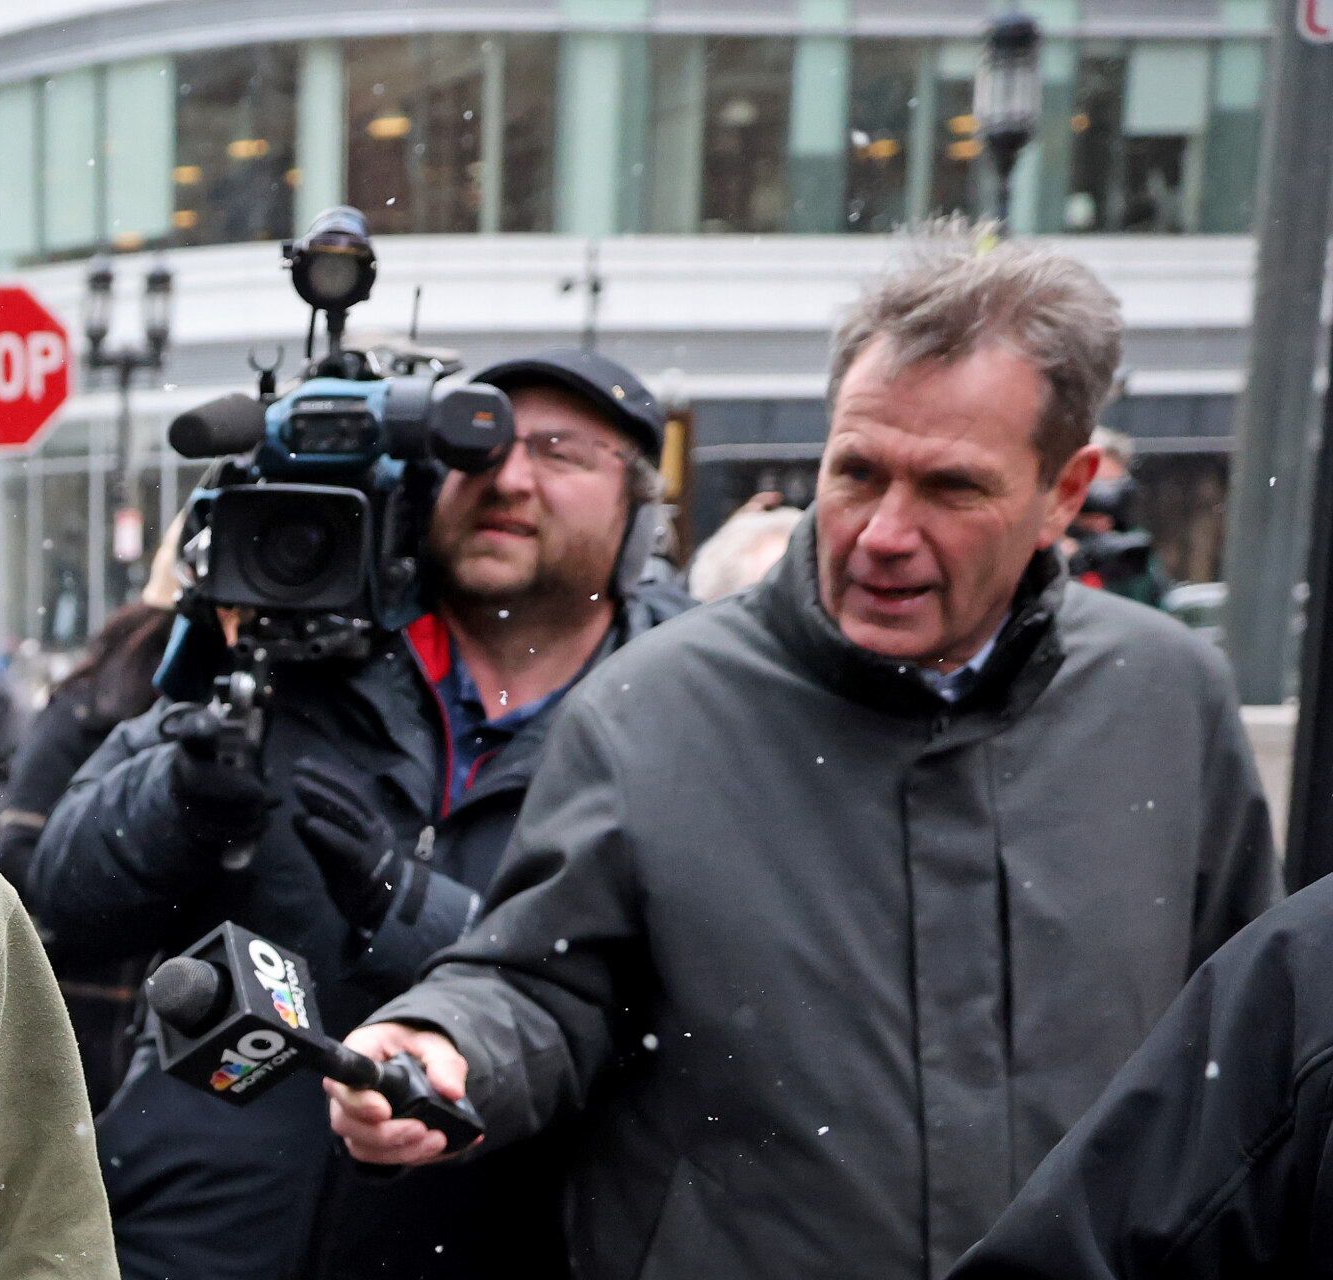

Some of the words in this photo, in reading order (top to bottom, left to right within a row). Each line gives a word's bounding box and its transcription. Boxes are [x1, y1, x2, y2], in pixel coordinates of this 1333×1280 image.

[248, 939, 290, 991] 10
[220, 1029, 285, 1069] 10
[231, 1047, 297, 1093] BOSTON
